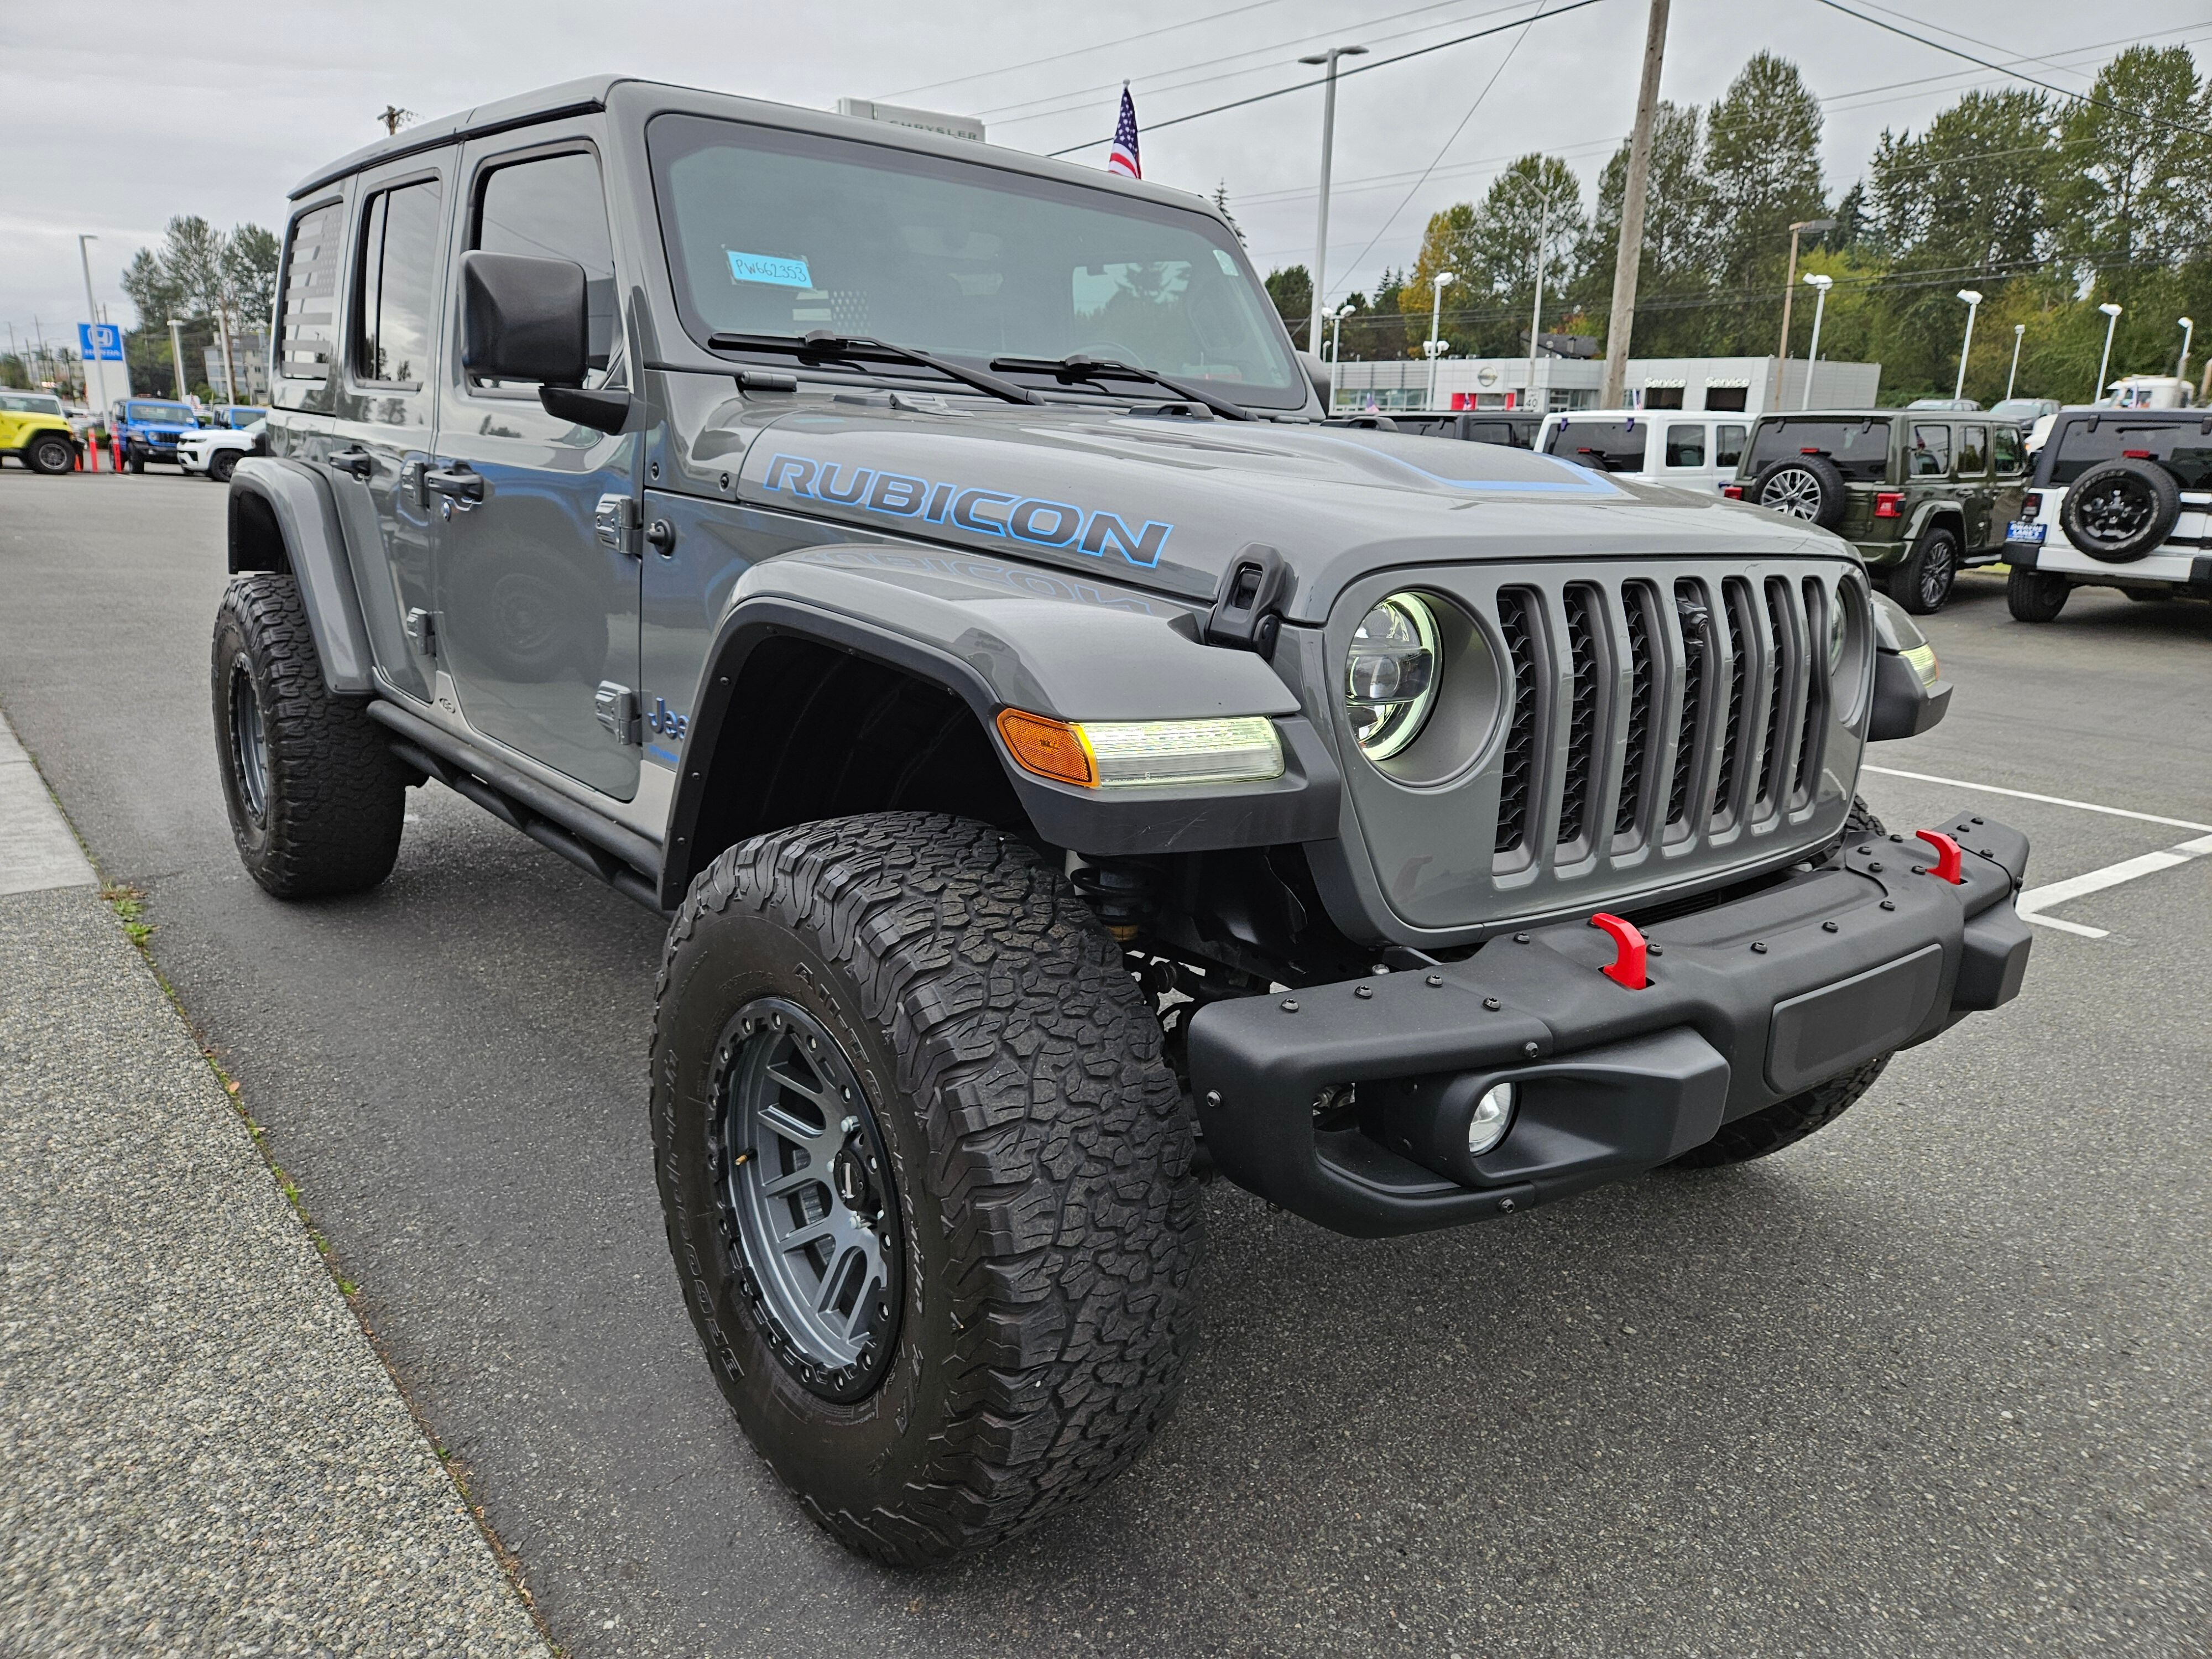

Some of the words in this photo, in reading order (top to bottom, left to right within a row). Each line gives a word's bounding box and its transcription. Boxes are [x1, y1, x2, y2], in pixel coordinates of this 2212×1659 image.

[735, 259, 807, 282] PW662353
[84, 348, 122, 357] HNDA
[1644, 377, 1687, 388] Service
[1705, 376, 1751, 388] Service
[1525, 398, 1538, 408] 40
[763, 453, 1173, 568] RUBICON
[646, 697, 690, 742] Jee
